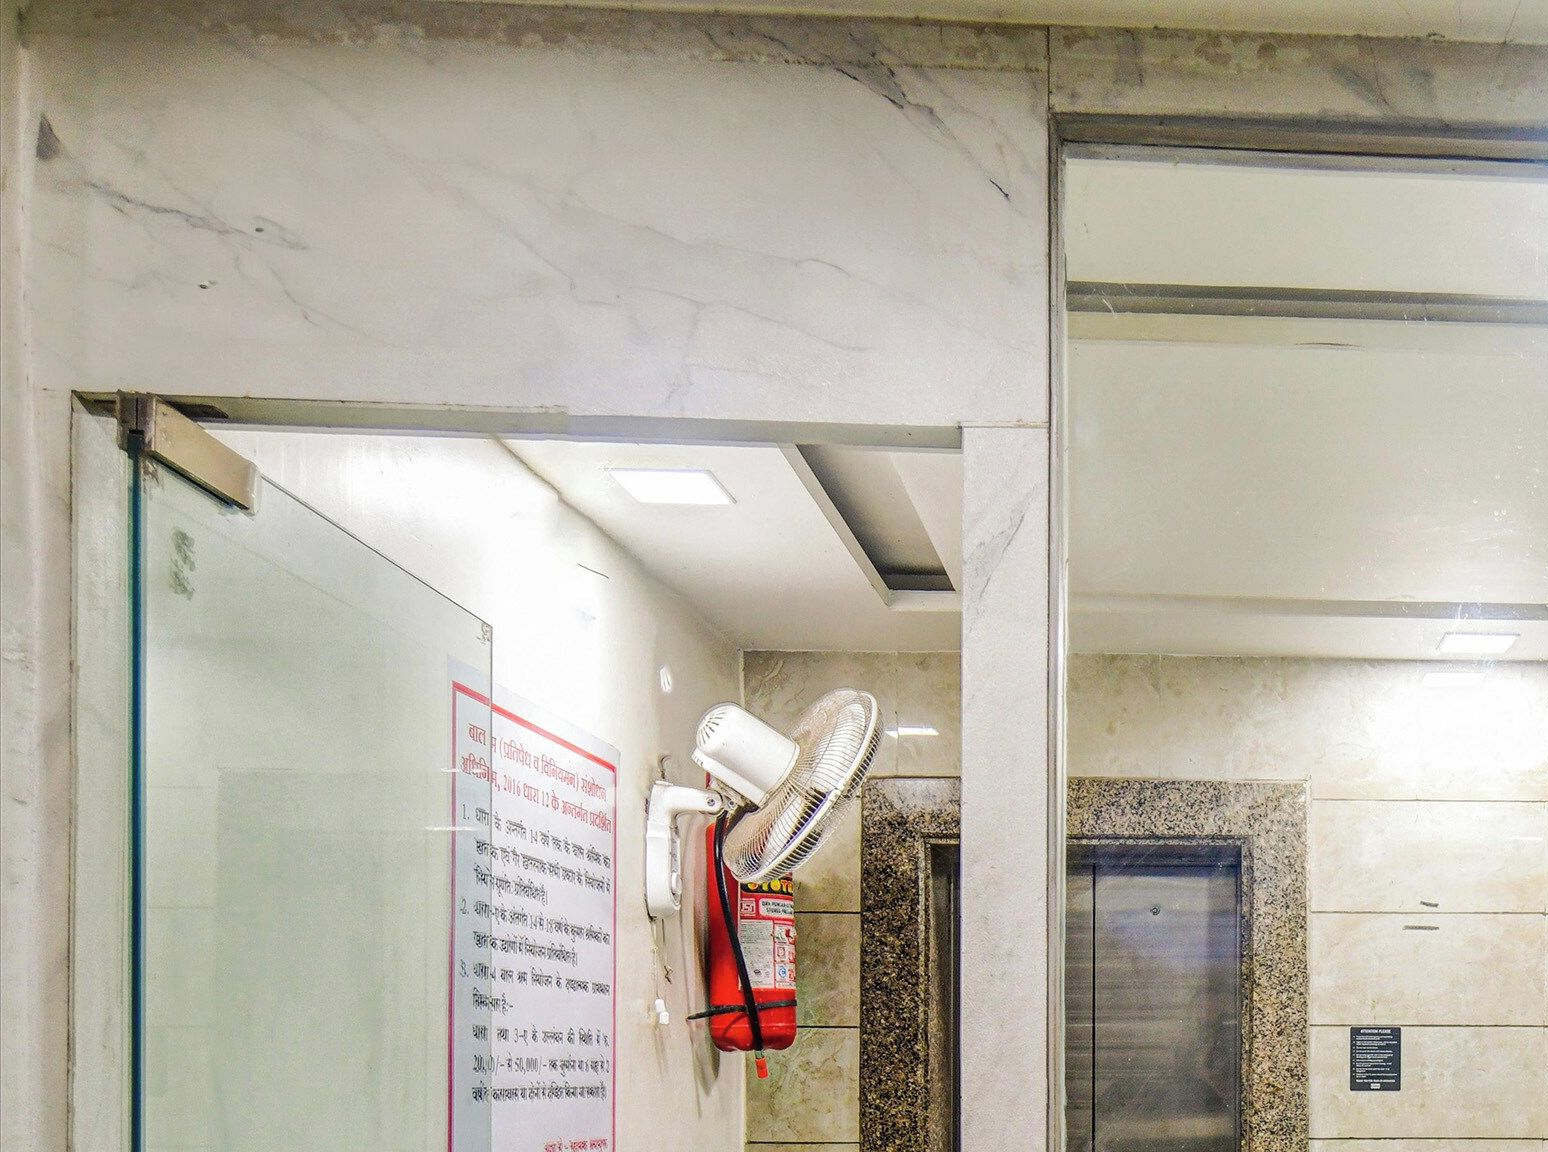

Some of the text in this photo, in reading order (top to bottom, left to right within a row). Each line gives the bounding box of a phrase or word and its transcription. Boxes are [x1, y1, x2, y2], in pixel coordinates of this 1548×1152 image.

[468, 723, 486, 746] बाल
[503, 774, 520, 796] 2016
[523, 782, 539, 803] धारा
[550, 789, 559, 811] के
